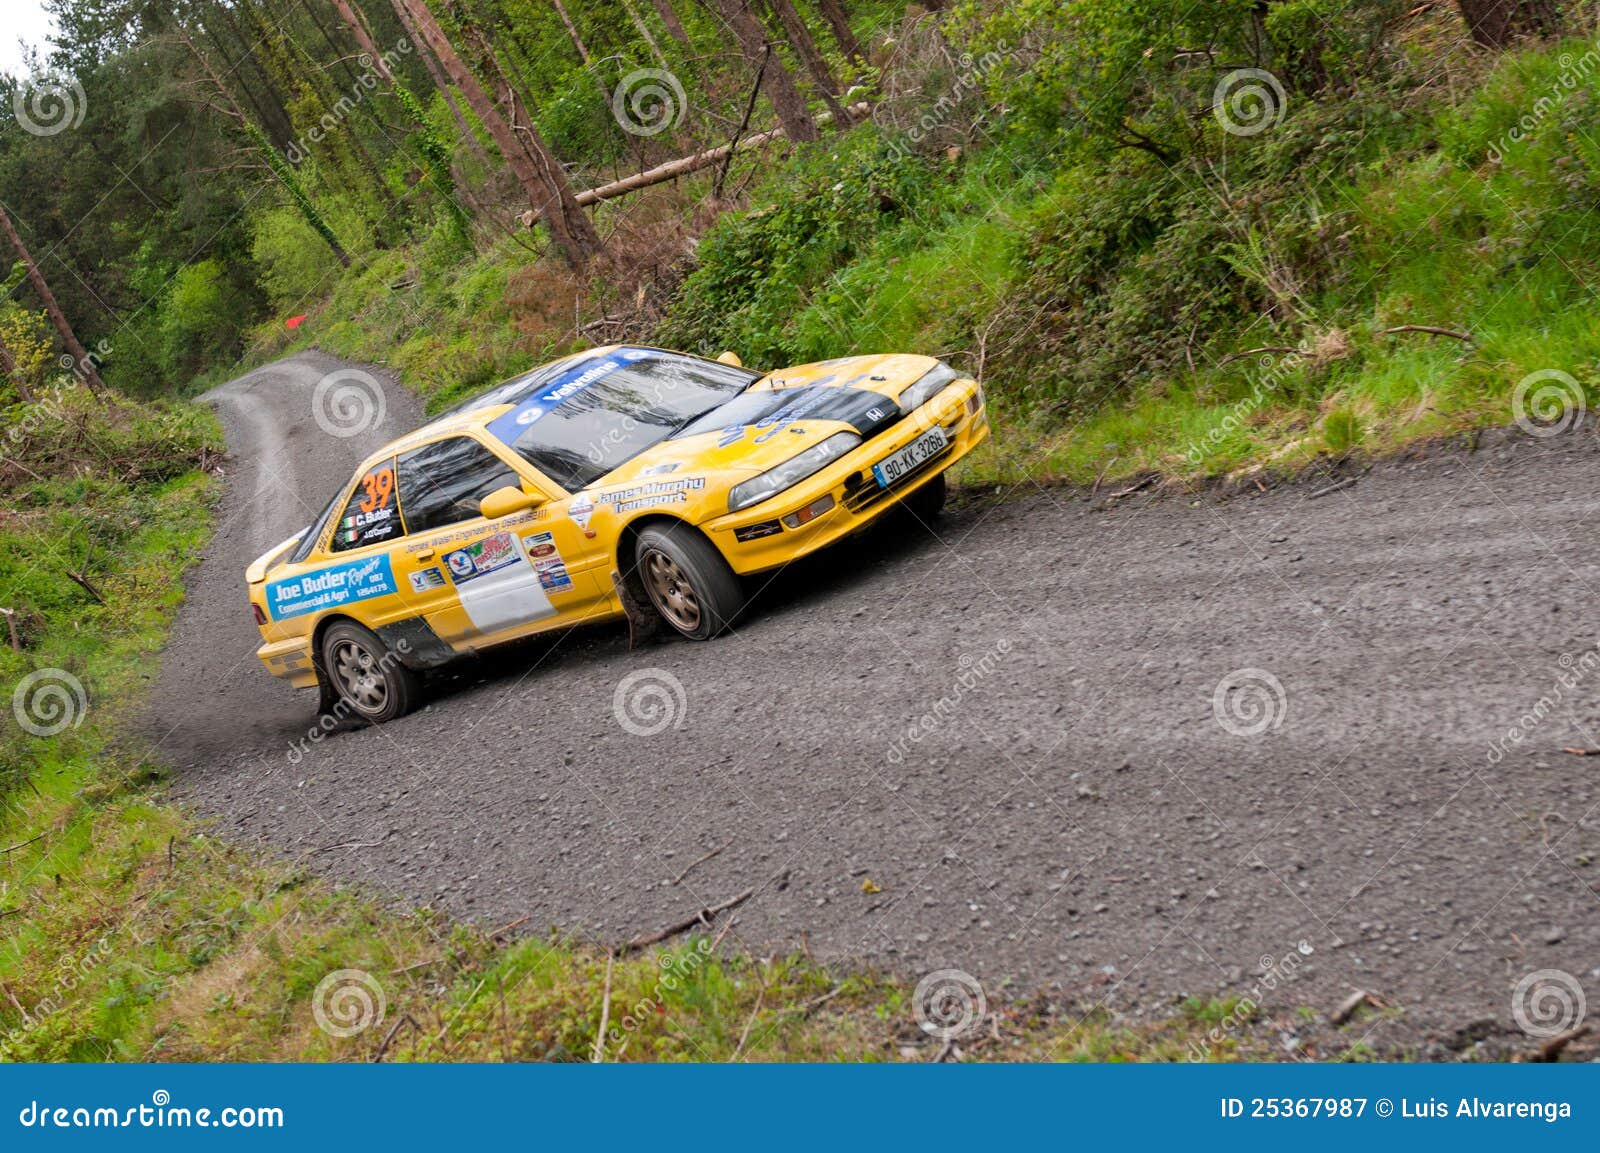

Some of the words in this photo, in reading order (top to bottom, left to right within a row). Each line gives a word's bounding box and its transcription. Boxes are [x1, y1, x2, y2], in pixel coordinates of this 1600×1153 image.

[542, 361, 620, 401] Valvoline
[360, 468, 393, 512] 39
[595, 488, 641, 506] James
[641, 477, 705, 497] Murphy
[614, 491, 687, 514] Transport
[365, 508, 392, 524] Butler
[275, 584, 300, 602] Joe
[301, 571, 348, 595] Butler
[278, 595, 325, 614] Commercial
[331, 588, 349, 602] Agri
